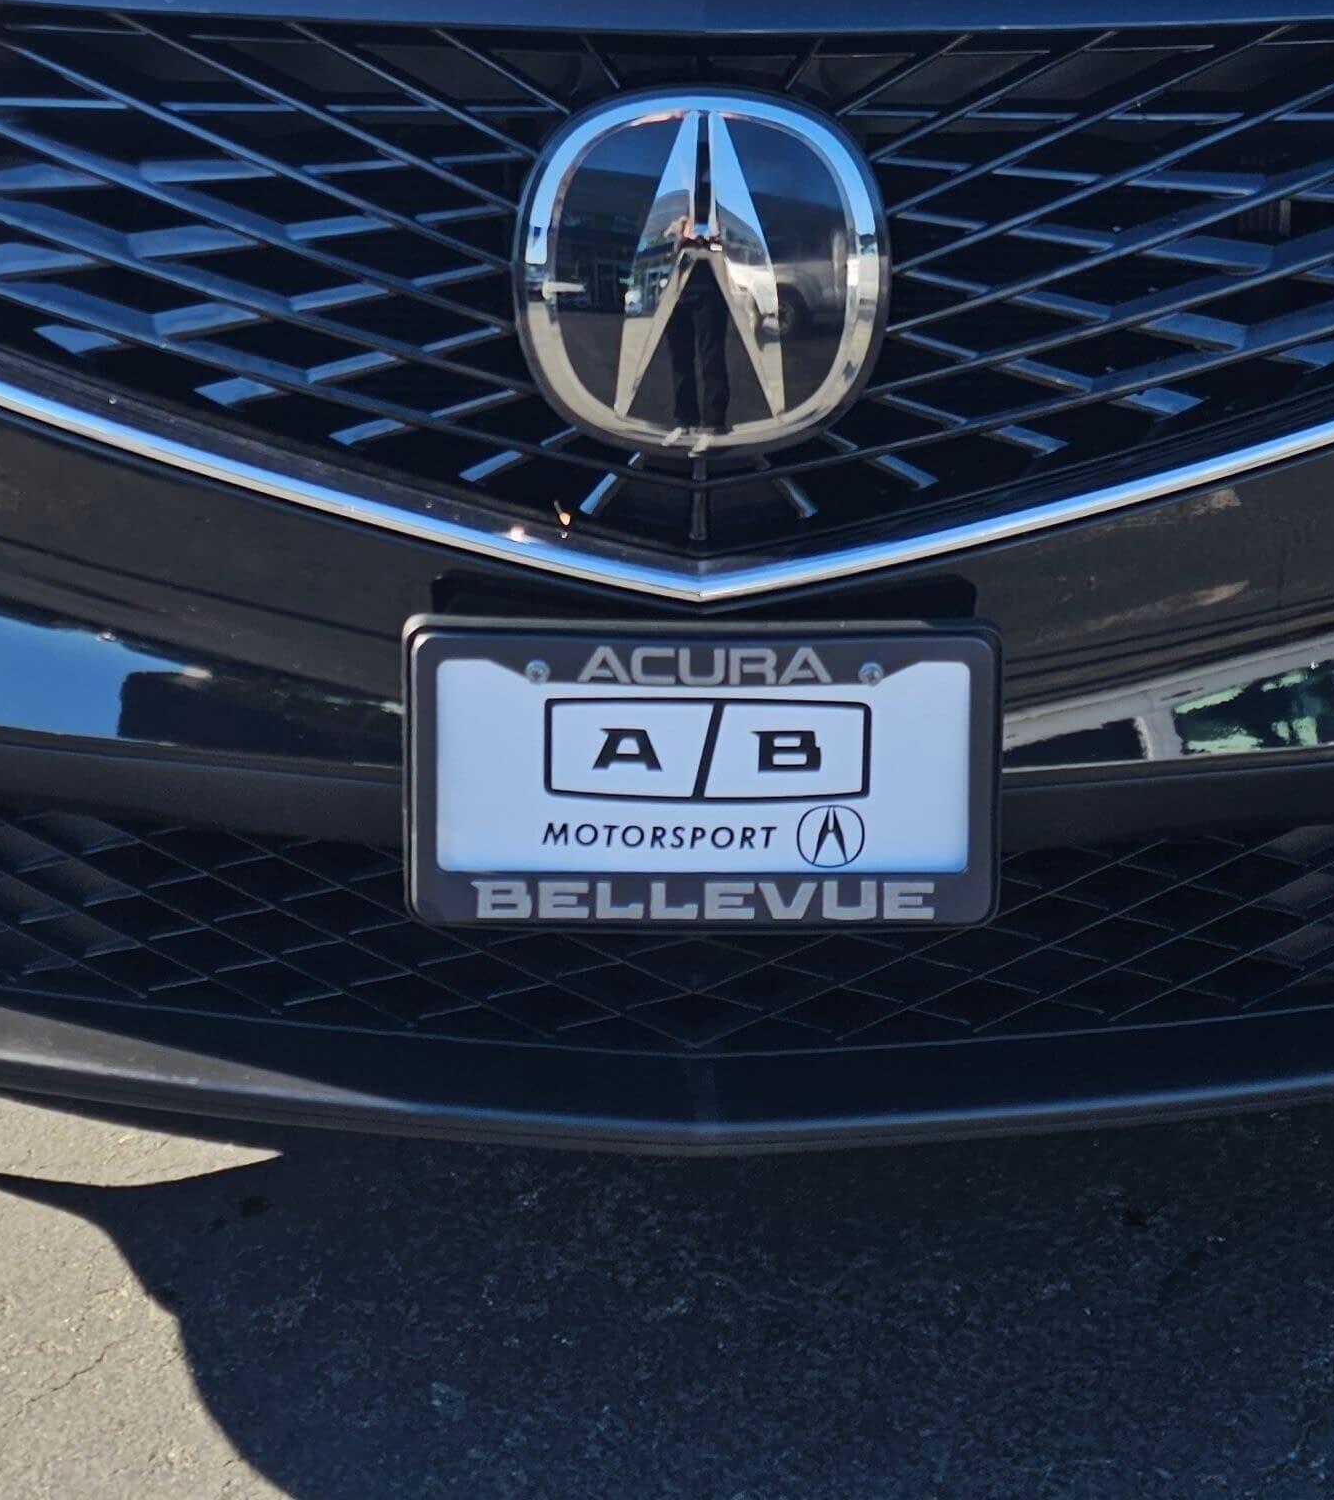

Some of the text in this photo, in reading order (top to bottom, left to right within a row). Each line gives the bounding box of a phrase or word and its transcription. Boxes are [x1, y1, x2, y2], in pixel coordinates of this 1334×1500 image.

[578, 645, 833, 686] ACURA
[542, 821, 778, 850] MOTORSPORT
[471, 880, 936, 921] BELLEVUE
